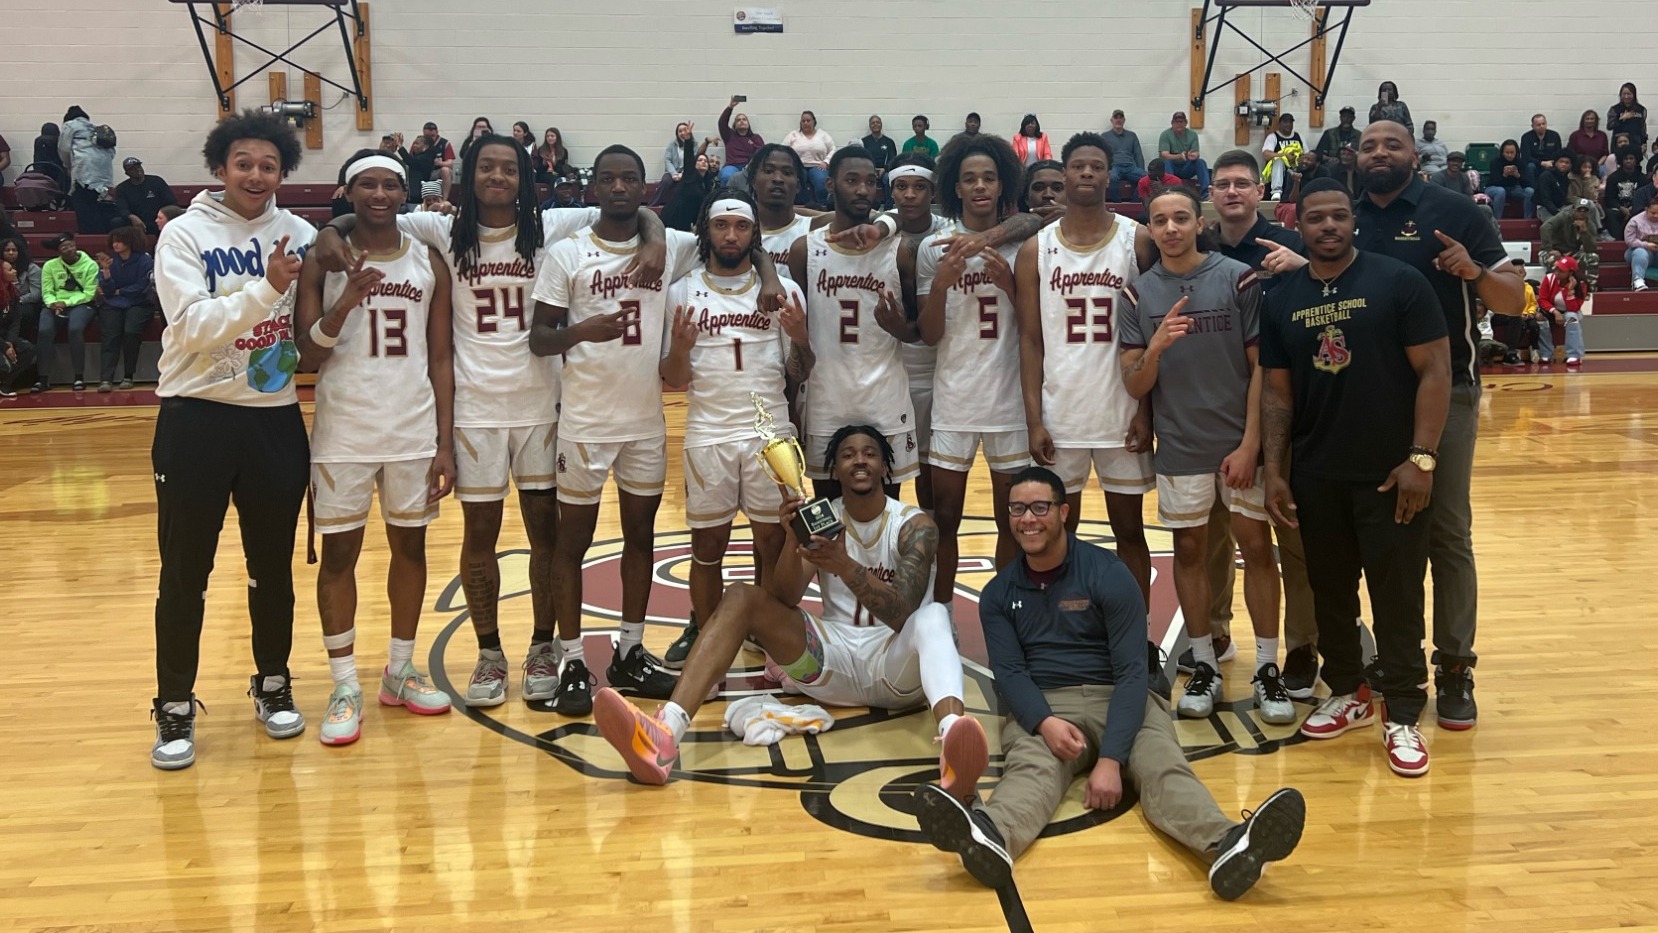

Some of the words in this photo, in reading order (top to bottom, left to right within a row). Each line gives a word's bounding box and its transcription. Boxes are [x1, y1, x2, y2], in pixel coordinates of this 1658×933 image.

[201, 237, 265, 293] good
[457, 256, 535, 287] Apprentice
[816, 268, 886, 298] Apprentice
[1050, 266, 1124, 296] Apprentice
[252, 313, 293, 337] STAC
[470, 286, 527, 335] 24
[698, 307, 772, 337] Apprentice
[838, 299, 860, 345] 2
[976, 295, 1000, 340] 5
[1063, 297, 1114, 344] 23
[1291, 303, 1336, 322] APPRENTICE
[1338, 298, 1367, 311] SCHOOL
[1305, 310, 1351, 328] BASKETBALL
[234, 333, 276, 351] GOOD
[367, 308, 409, 358] 13
[733, 337, 744, 372] 1
